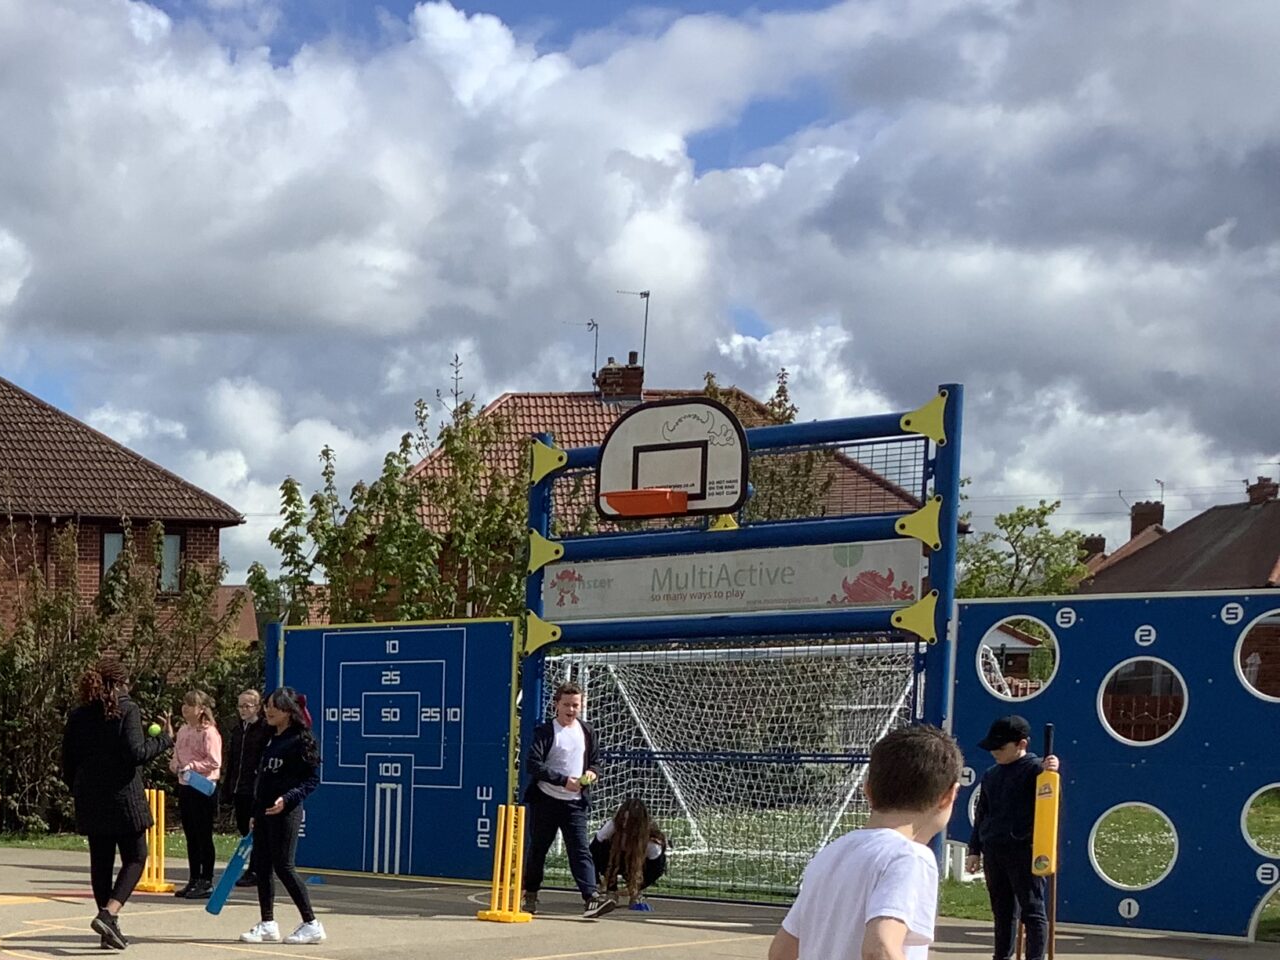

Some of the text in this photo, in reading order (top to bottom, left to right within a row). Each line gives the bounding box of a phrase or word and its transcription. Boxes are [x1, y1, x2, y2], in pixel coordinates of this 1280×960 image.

[651, 562, 796, 592] MultiActive
[650, 588, 746, 602] so many ways to play
[1060, 611, 1073, 625] 5
[1225, 606, 1239, 621] 5
[1139, 628, 1152, 643] 2
[385, 640, 399, 654] 10
[381, 671, 401, 685] 25
[325, 708, 461, 722] 10 25 50 25 10
[379, 763, 402, 777] 100
[961, 770, 973, 784] 4
[1260, 866, 1275, 881] 3
